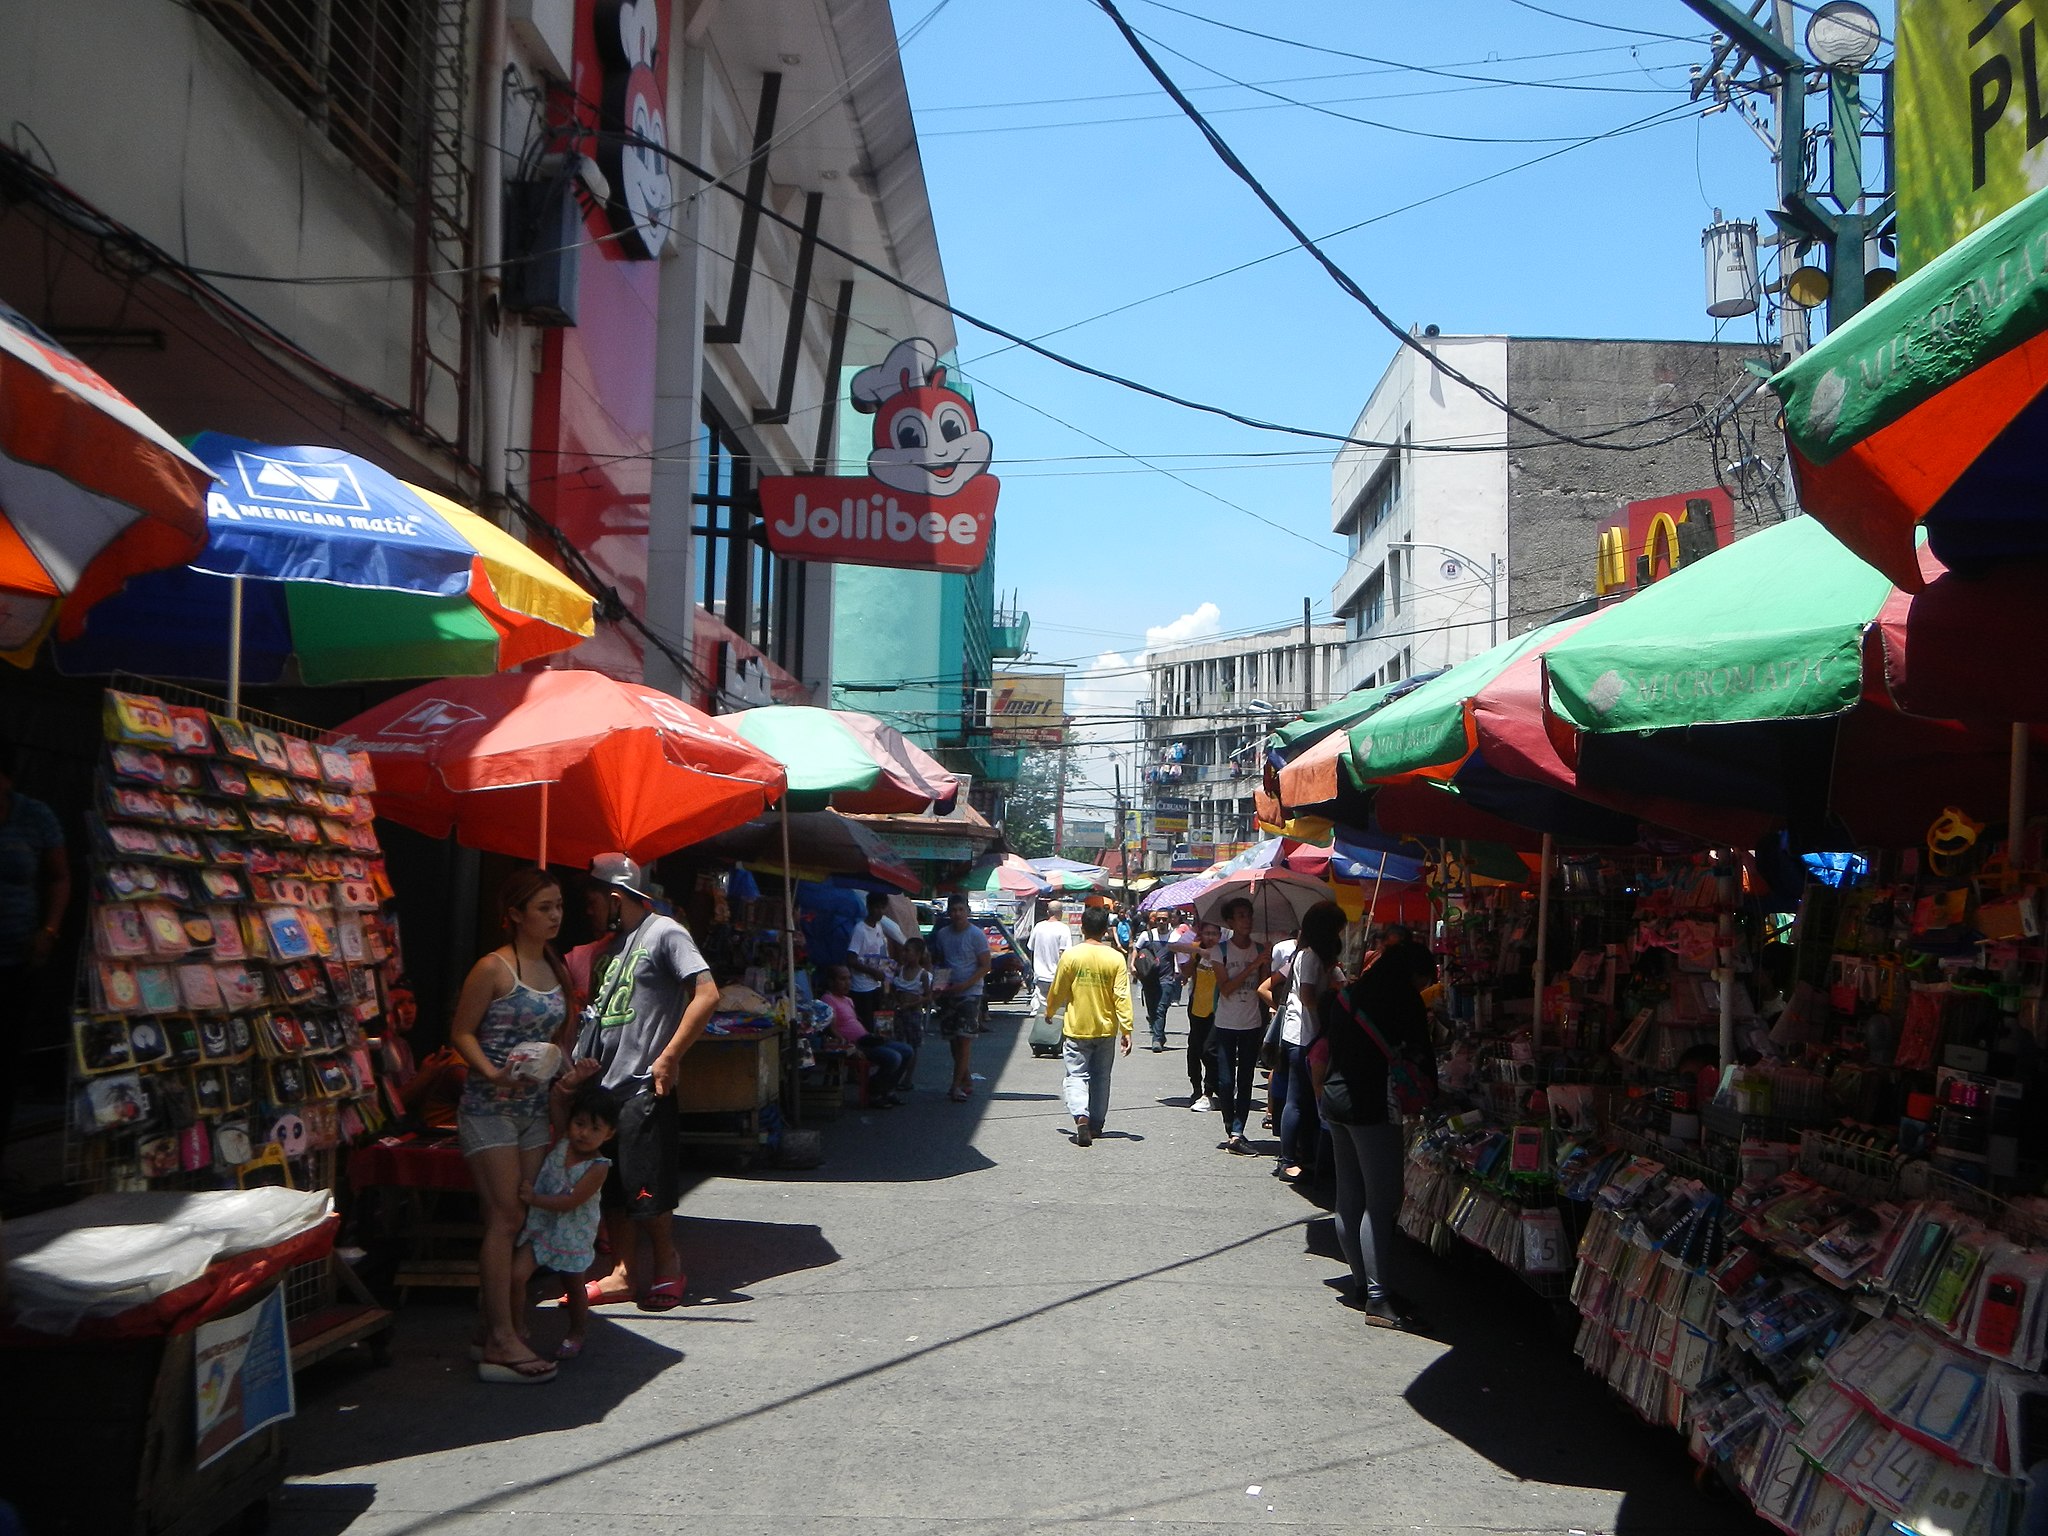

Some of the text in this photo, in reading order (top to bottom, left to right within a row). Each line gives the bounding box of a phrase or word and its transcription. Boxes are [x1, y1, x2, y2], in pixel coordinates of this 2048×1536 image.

[347, 513, 417, 537] matic
[774, 494, 979, 544] Jollibee
[1634, 655, 1839, 702] MICROMATIC
[1157, 800, 1187, 811] CEBUANA
[1541, 1238, 1557, 1261] 5
